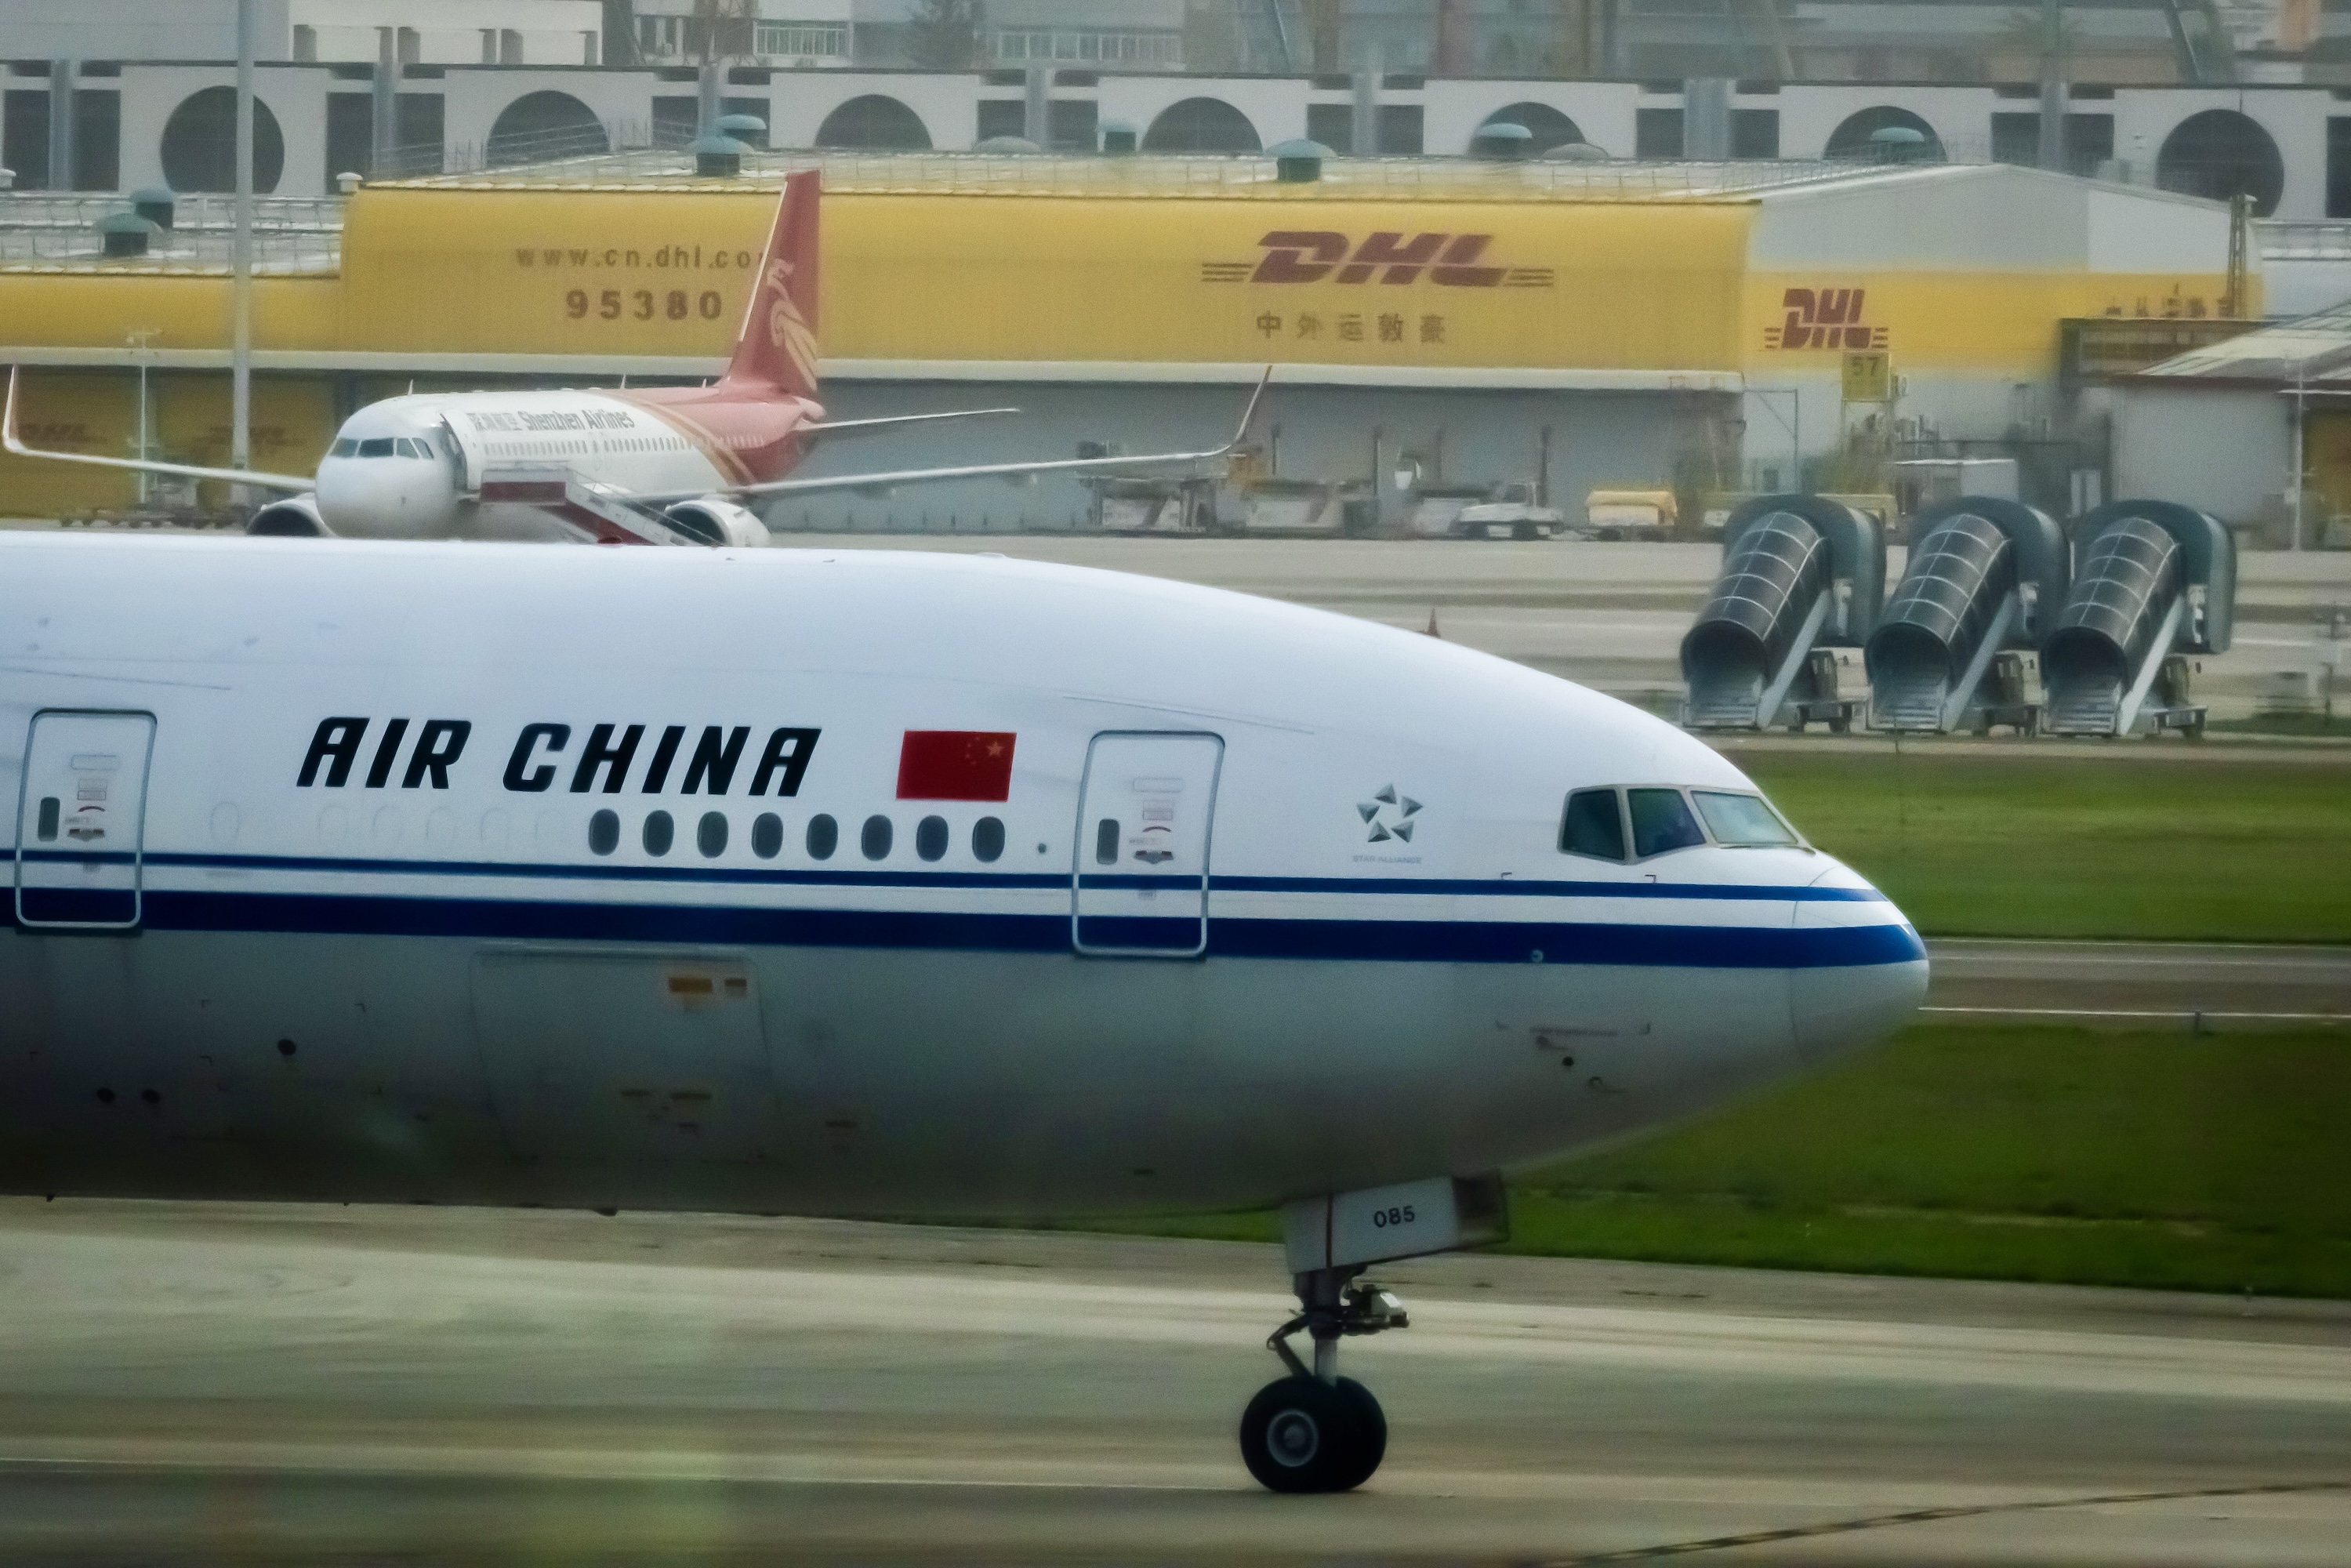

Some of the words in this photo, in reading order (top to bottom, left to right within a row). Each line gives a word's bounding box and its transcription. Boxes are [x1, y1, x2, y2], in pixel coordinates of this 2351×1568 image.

[516, 245, 762, 269] www.cn.dhl.co
[1250, 230, 1507, 287] DHL
[565, 289, 723, 320] 95380
[1781, 289, 1871, 349] DHL
[517, 410, 586, 430] Shenzhen
[582, 408, 635, 429] Airlines
[296, 717, 471, 789] AIR
[502, 723, 822, 797] CHINA
[1373, 1206, 1415, 1228] 085
